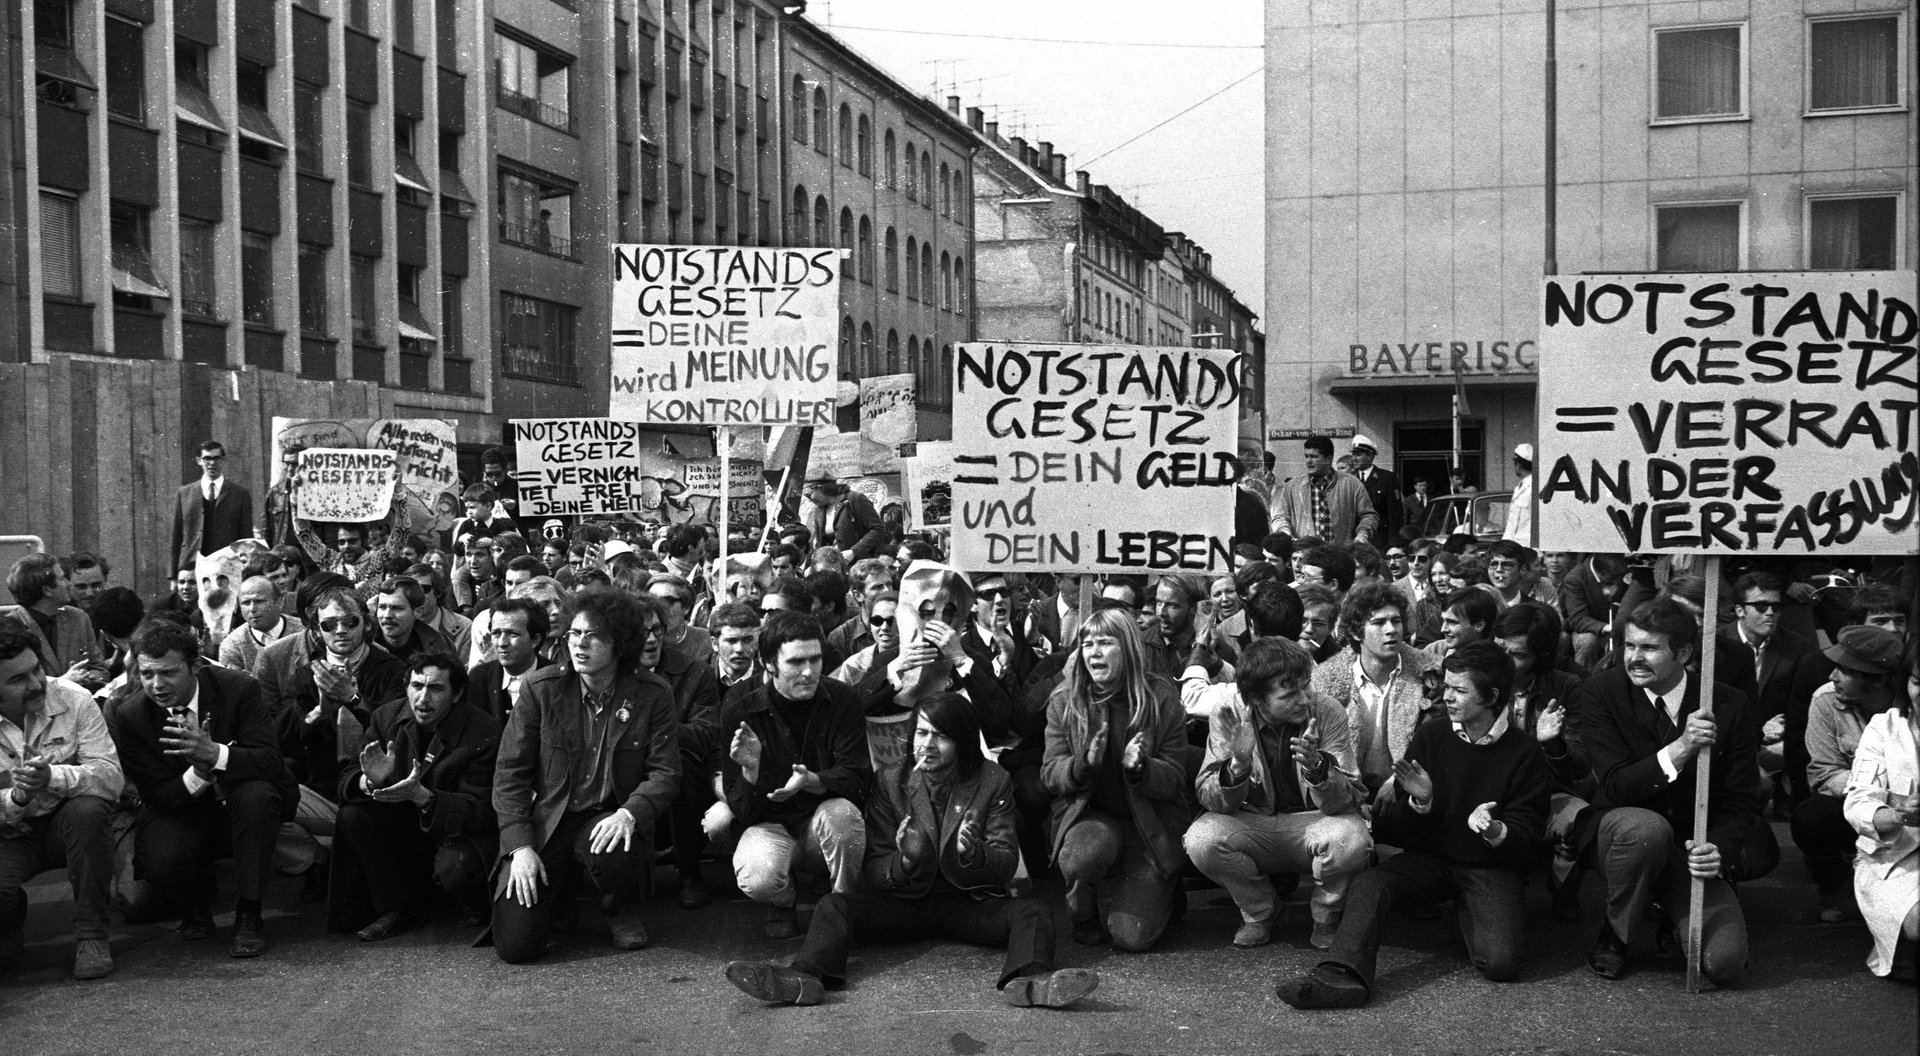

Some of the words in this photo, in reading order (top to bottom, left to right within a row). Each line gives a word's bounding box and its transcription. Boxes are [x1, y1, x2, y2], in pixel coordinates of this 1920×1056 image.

[613, 247, 834, 287] NOTSTANDS
[638, 285, 802, 319] GESETZ
[1545, 280, 1918, 344] NOTSTAND
[650, 321, 749, 346] DEINE
[613, 361, 677, 393] wird
[685, 345, 830, 389] MEINUNG
[957, 346, 1241, 410] NOTSTANDS
[1651, 336, 1918, 390] GESETZ
[517, 420, 637, 442] NOTSTANDS
[986, 398, 1210, 447] GESETZ
[1628, 398, 1918, 453] VERRAT
[303, 452, 392, 470] NOTSTANDS
[407, 461, 453, 483] nicht
[542, 441, 635, 463] GESETZ
[1009, 447, 1122, 484] DEIN
[1137, 451, 1245, 489] GELD
[308, 470, 386, 486] GESETZE
[520, 485, 558, 501] TET
[581, 483, 632, 501] FREI
[546, 466, 640, 484] VERNICH
[1539, 454, 1631, 504] AN
[1647, 455, 1782, 501] DER
[533, 500, 594, 516] DEINE
[601, 494, 642, 512] HEIT
[963, 486, 1036, 529] und
[984, 531, 1080, 564] DEIN
[1096, 529, 1236, 573] LEBEN
